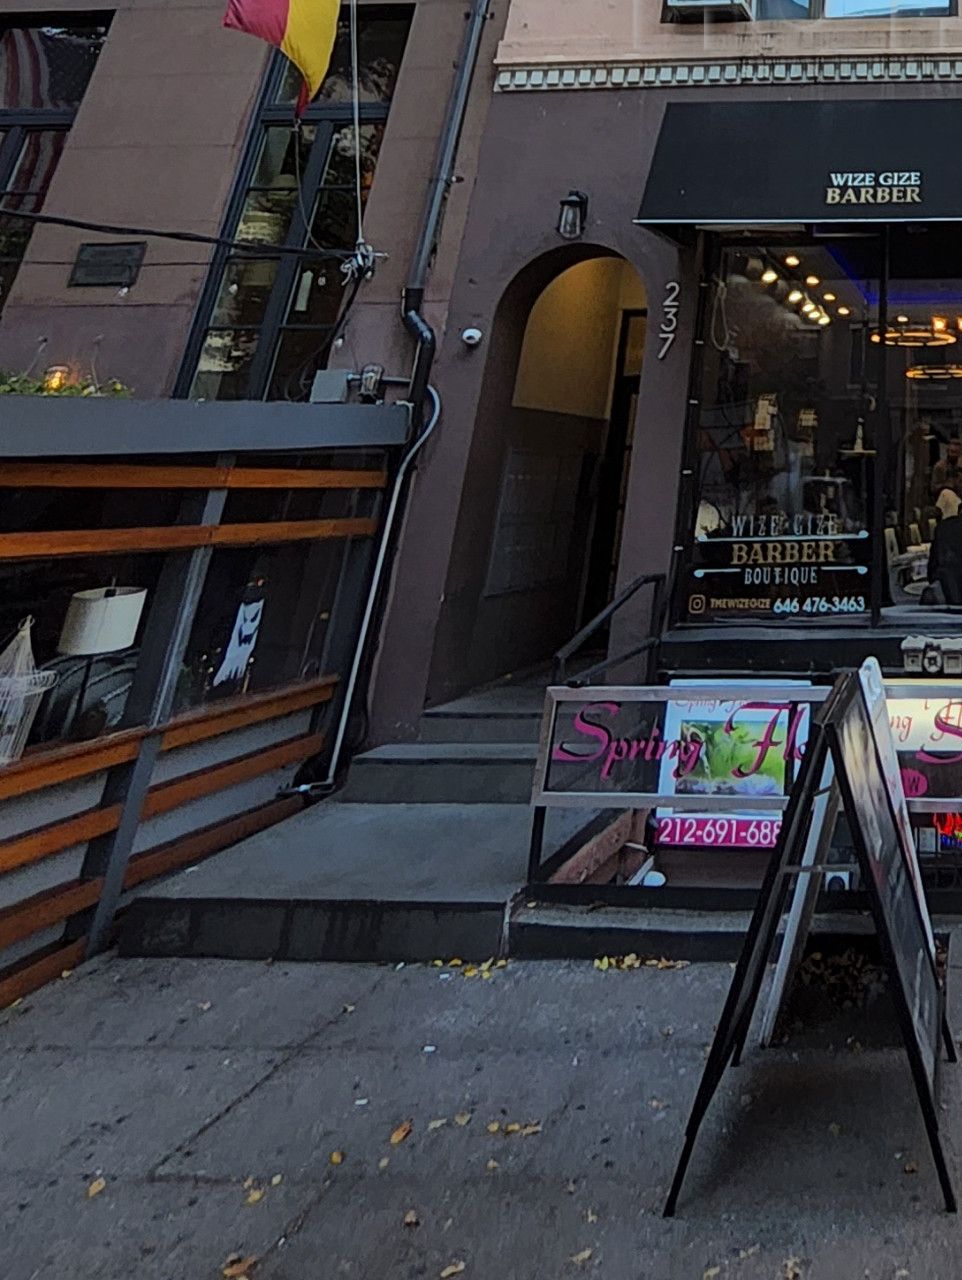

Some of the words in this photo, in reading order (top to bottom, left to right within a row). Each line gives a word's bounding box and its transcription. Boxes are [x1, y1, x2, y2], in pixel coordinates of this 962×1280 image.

[830, 173, 875, 186] WIZE
[879, 172, 921, 185] GIZE
[826, 187, 922, 204] BARBER
[657, 281, 681, 360] 237
[731, 514, 780, 537] WIZE
[730, 541, 836, 565] BARBER
[744, 567, 818, 586] BOUTIQUE
[773, 597, 799, 613] 646
[802, 596, 865, 612] 476-3463
[552, 699, 704, 780] Spring
